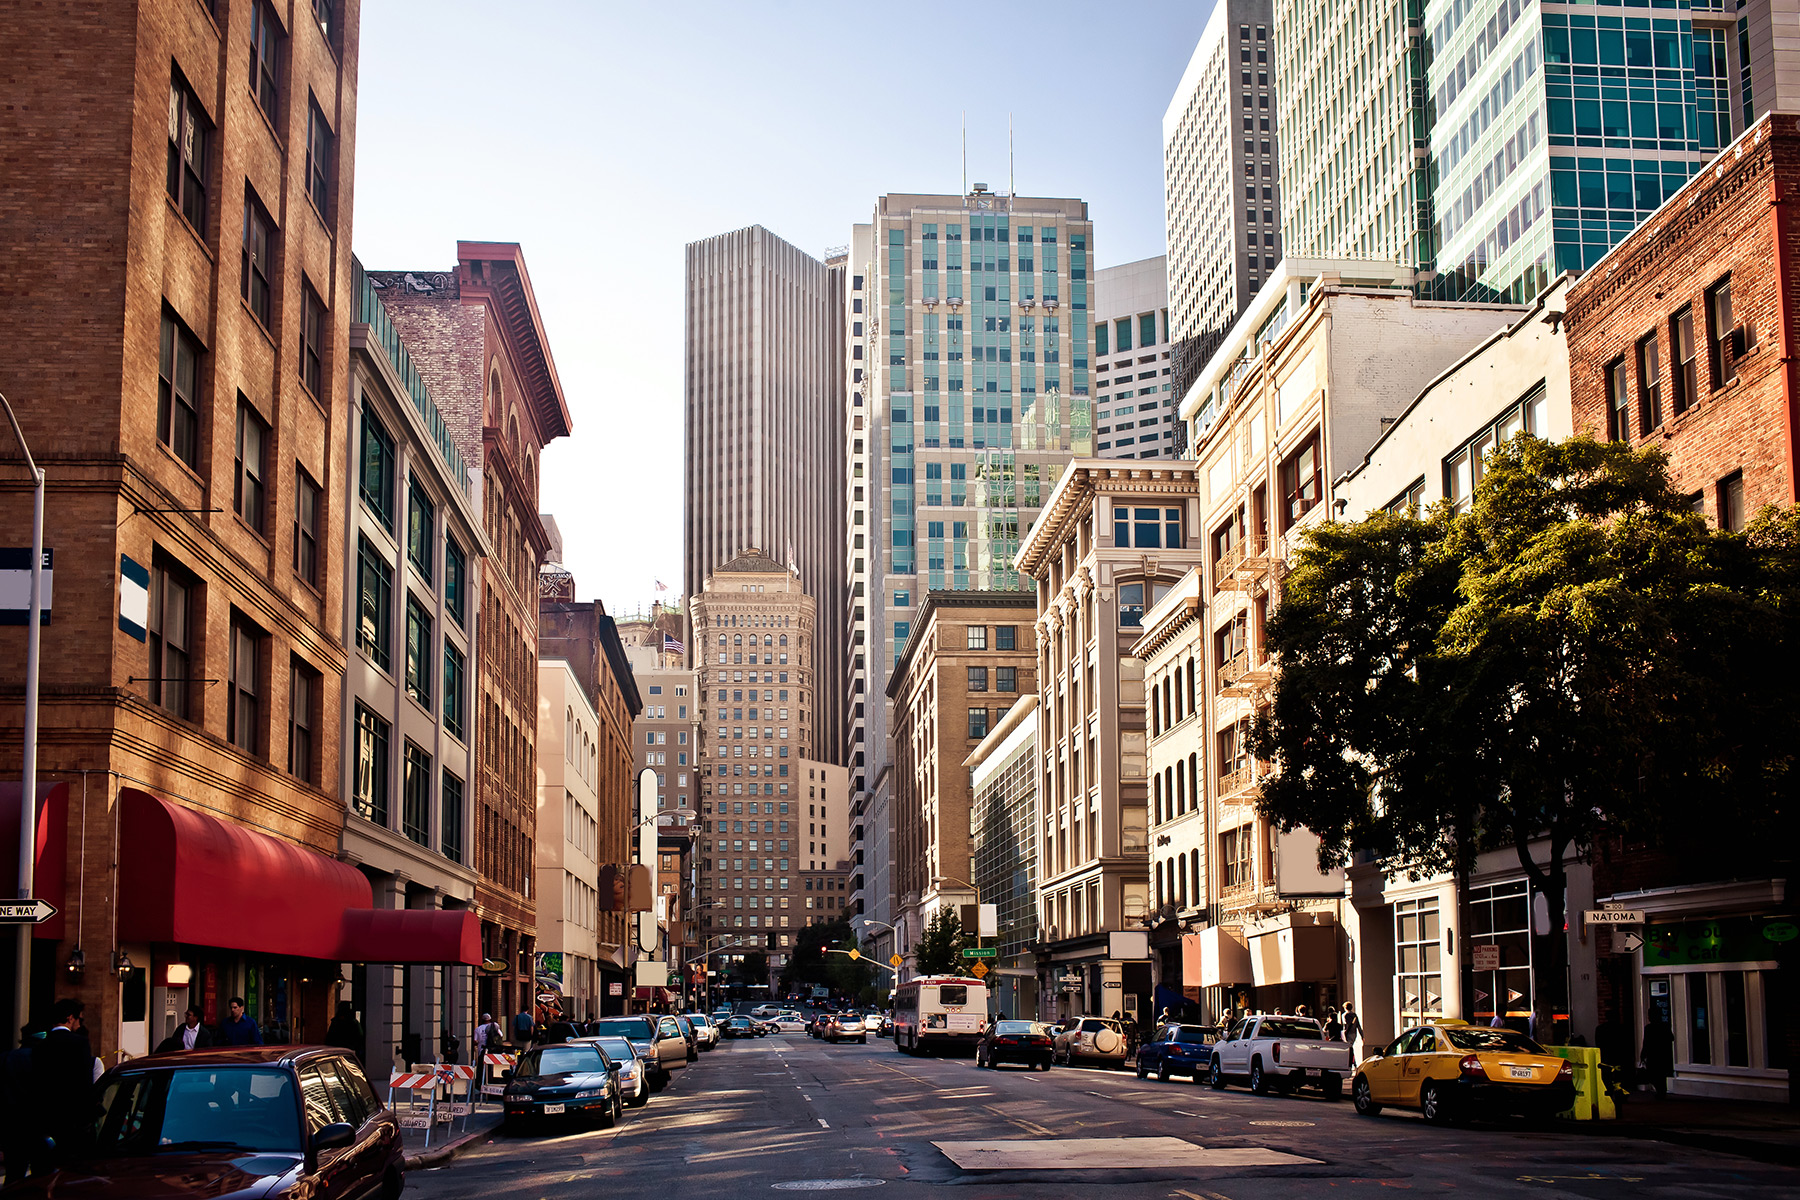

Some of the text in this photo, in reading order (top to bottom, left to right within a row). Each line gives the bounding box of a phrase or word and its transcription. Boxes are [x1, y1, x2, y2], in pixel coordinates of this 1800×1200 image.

[15, 906, 37, 916] WAY
[1592, 913, 1636, 921] NATOMA
[1649, 928, 1679, 946] Bay
